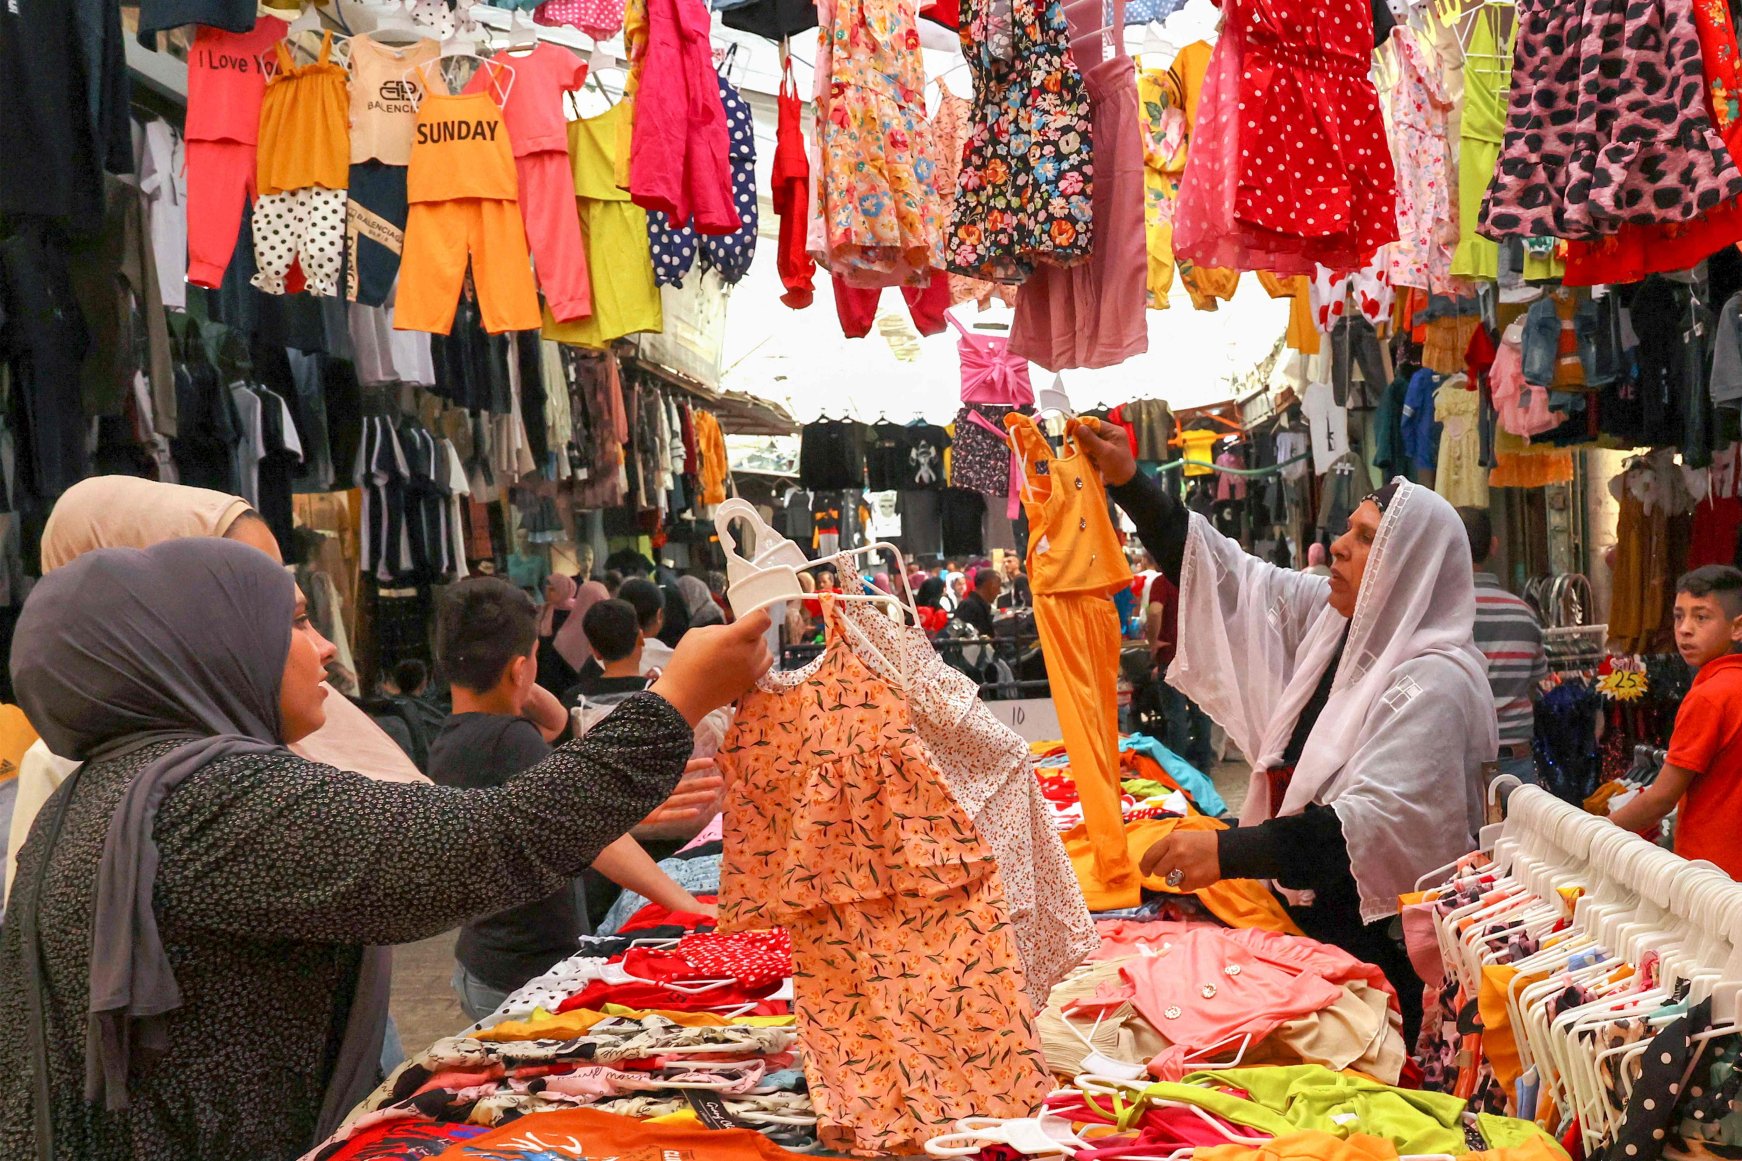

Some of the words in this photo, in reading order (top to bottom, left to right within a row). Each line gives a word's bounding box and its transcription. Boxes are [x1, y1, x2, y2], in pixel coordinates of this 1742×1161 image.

[199, 50, 203, 68] I
[208, 49, 248, 73] Love
[416, 120, 499, 145] SUNDAY
[1615, 669, 1637, 688] 25
[1012, 706, 1025, 725] 10
